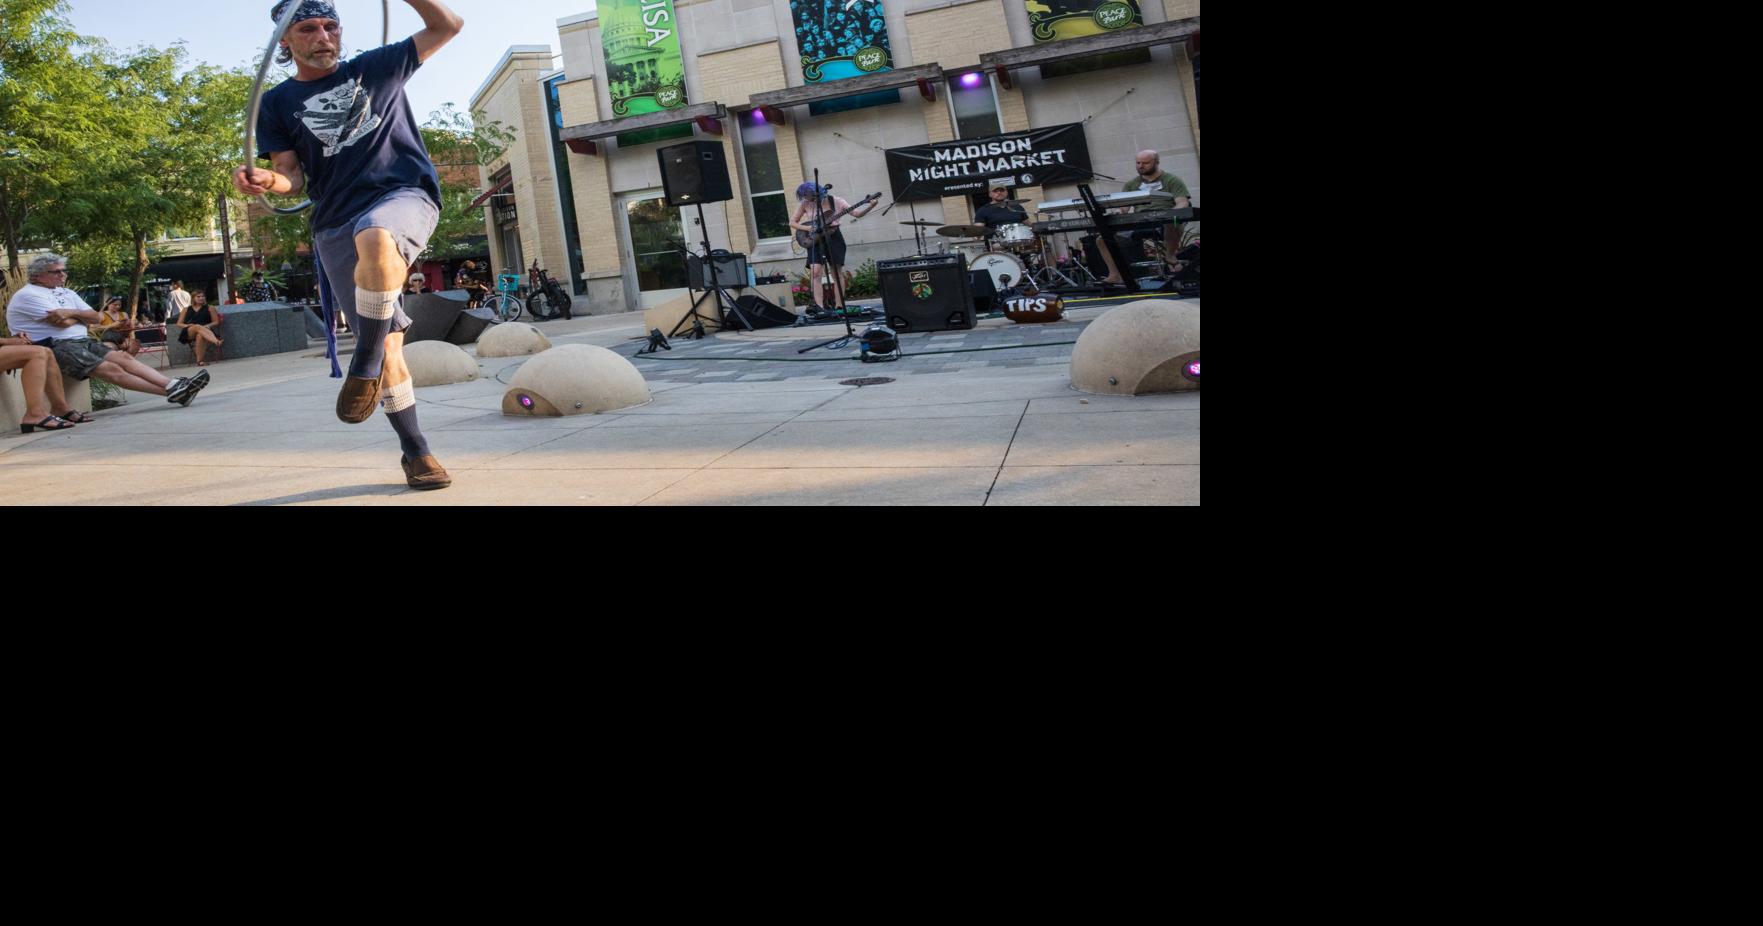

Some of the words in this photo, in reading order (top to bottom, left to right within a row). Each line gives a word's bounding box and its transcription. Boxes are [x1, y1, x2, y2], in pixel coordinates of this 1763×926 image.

[1099, 7, 1127, 18] PEACE
[1103, 13, 1126, 24] Park
[641, 0, 671, 47] ISA
[858, 52, 881, 62] PEACE
[658, 89, 678, 98] PEACE
[933, 138, 1032, 162] MADISON
[908, 162, 971, 182] NIGHT
[978, 149, 1066, 174] MARKET
[1006, 297, 1047, 313] TIPS
